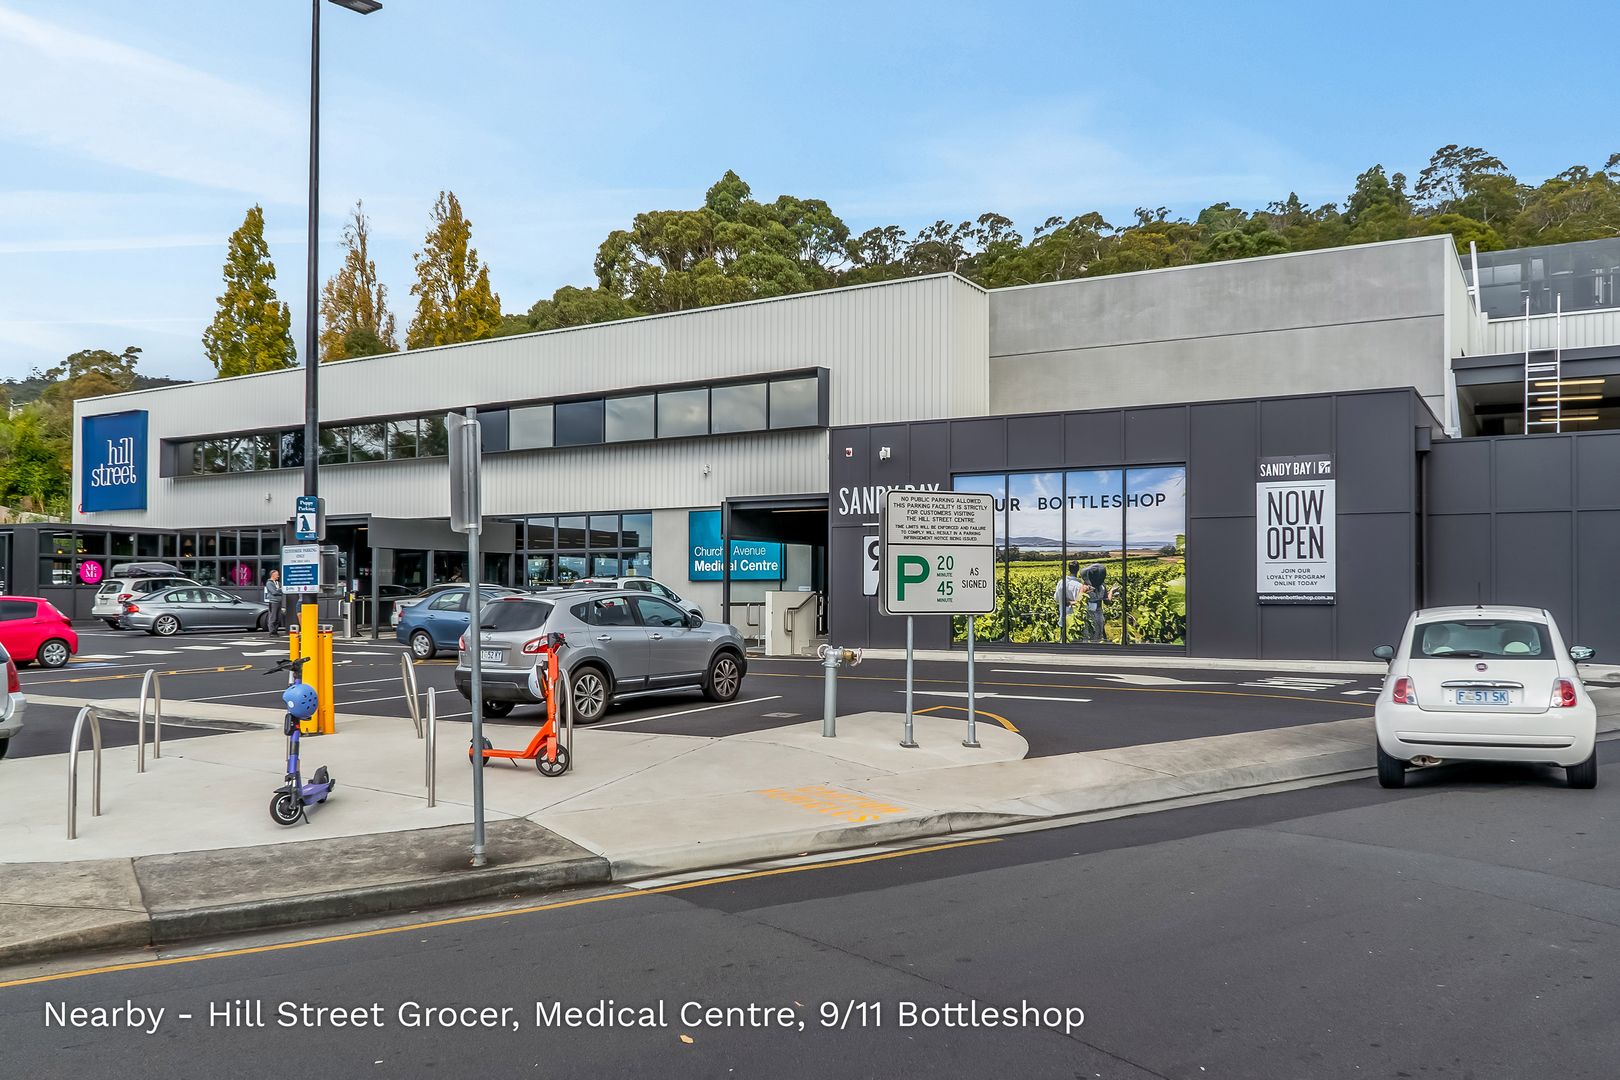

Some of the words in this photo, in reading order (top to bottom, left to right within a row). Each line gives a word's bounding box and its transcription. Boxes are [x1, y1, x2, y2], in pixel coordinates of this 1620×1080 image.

[107, 437, 133, 466] hill
[91, 463, 137, 487] street
[1260, 463, 1292, 477] SANDY
[1294, 461, 1312, 475] BAY
[1038, 493, 1166, 511] BOTTLESHOP
[1268, 490, 1324, 526] NOW
[733, 545, 766, 556] Avenue
[1267, 526, 1324, 560] OPEN
[740, 559, 778, 571] Centre
[937, 555, 954, 570] 20
[897, 556, 930, 601] P
[970, 568, 979, 576] AS
[937, 581, 954, 596] 45
[962, 580, 987, 589] SIGNED
